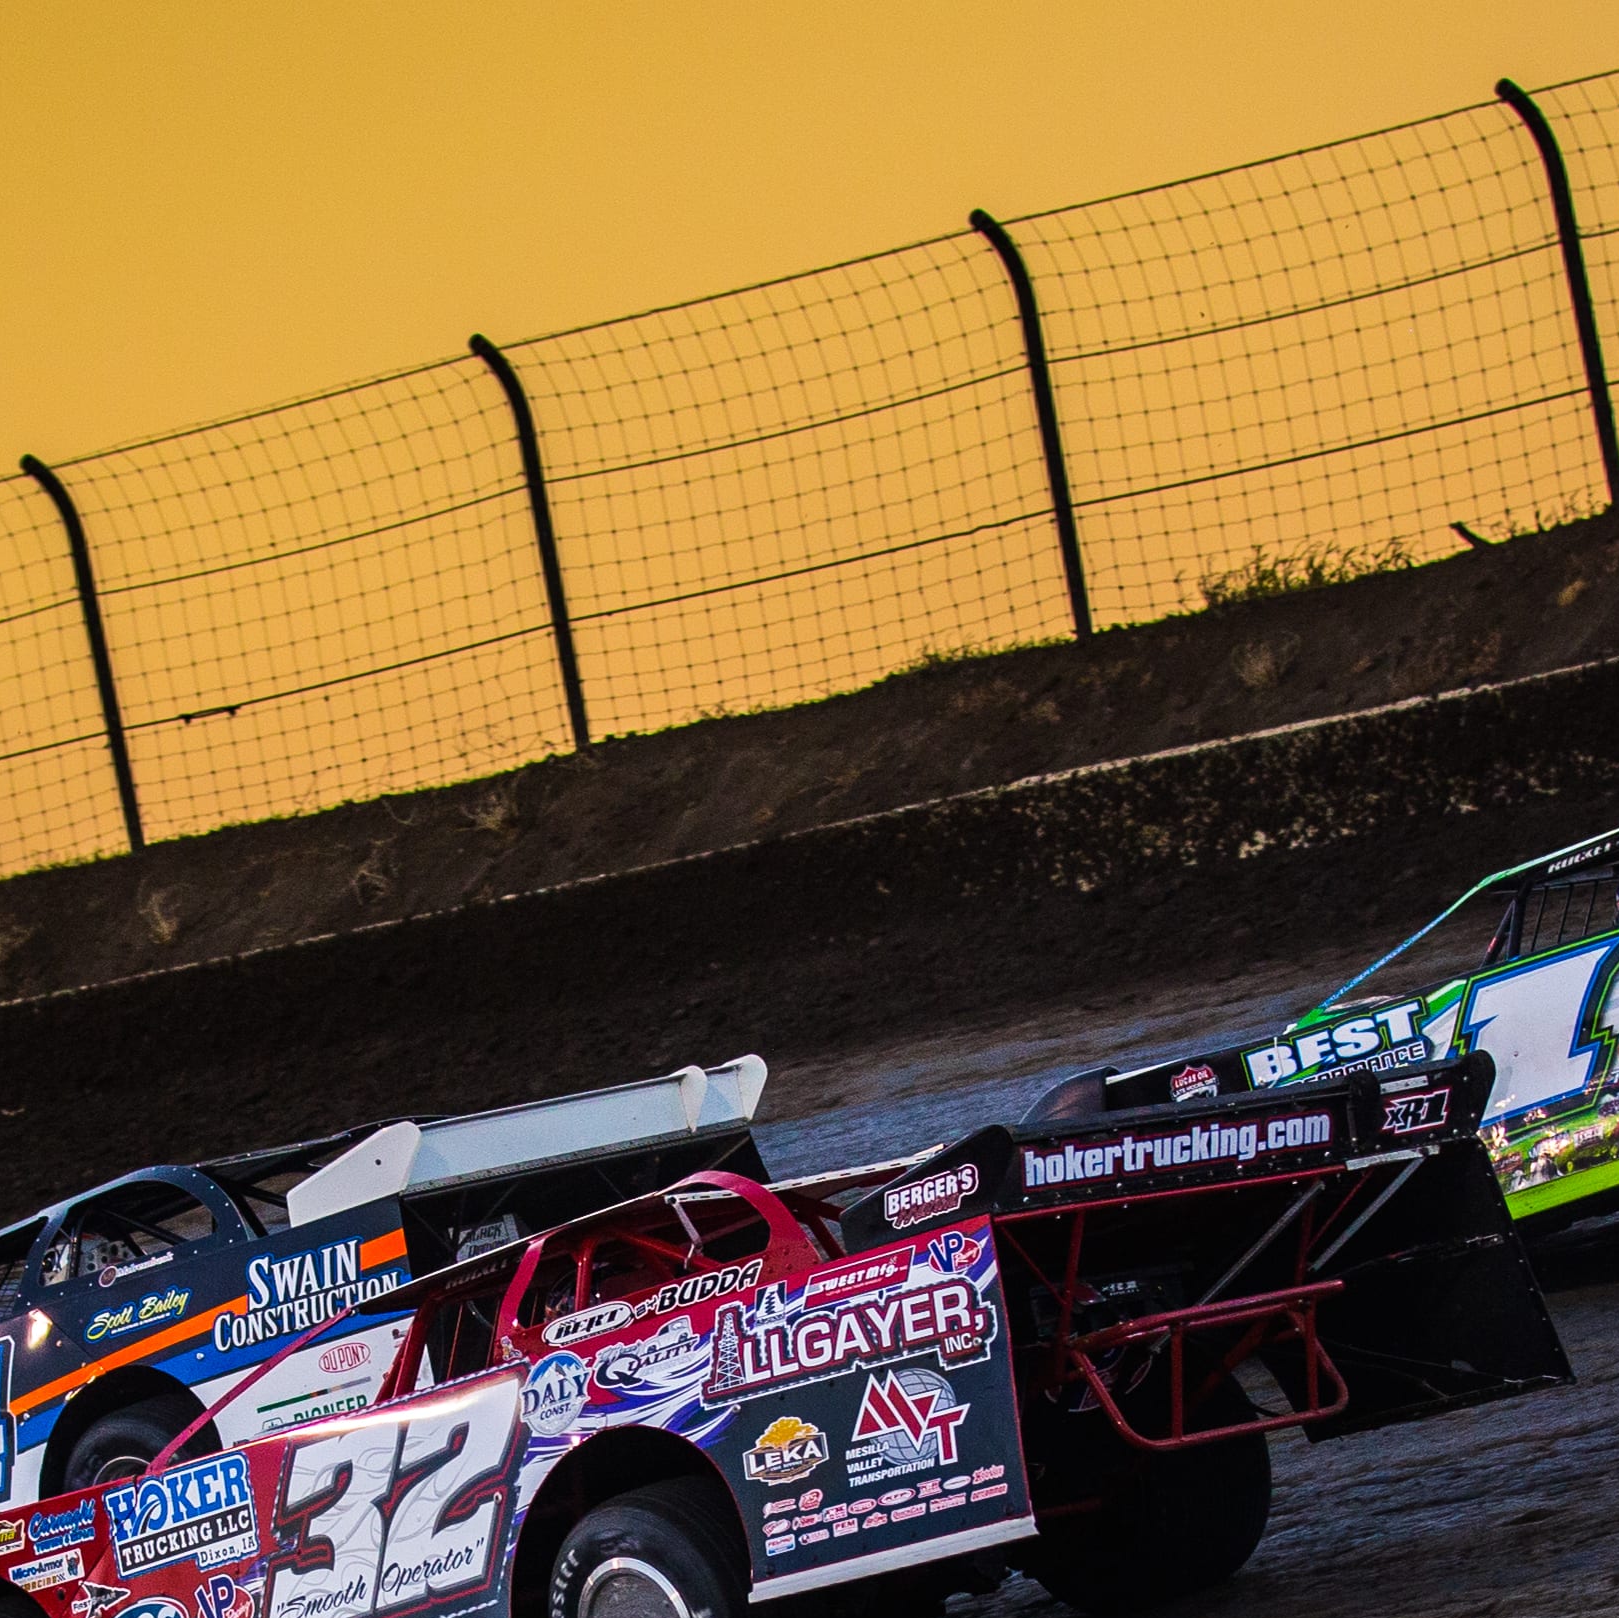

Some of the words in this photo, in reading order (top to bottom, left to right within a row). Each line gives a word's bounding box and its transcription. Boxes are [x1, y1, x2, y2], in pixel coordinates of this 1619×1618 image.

[1246, 1001, 1422, 1087] BEST
[1025, 1112, 1331, 1187] hokertrucking.com
[887, 1167, 974, 1217] BERGER'S
[930, 1232, 964, 1273] VP
[248, 1240, 359, 1312] SWAIN
[656, 1259, 763, 1314] BUDDA
[86, 1305, 133, 1340] Scott
[138, 1289, 190, 1320] Bailey
[213, 1270, 400, 1352] CONSTRUCTION
[944, 1332, 982, 1354] INC.
[522, 1372, 589, 1415] DALY
[539, 1402, 572, 1421] CONST.
[749, 1440, 823, 1474] LEKA
[845, 1441, 890, 1461] MESILLA
[846, 1457, 883, 1474] VALLEY
[848, 1457, 935, 1488] TRANSPORTATION
[107, 1456, 250, 1542] HOKER
[122, 1521, 213, 1567] TRUCKING
[216, 1509, 250, 1534] LLC
[200, 1545, 240, 1564] Dixon,
[241, 1537, 255, 1552] IA
[12, 1556, 64, 1581] Micro-Armor
[381, 1537, 485, 1596] Operator"
